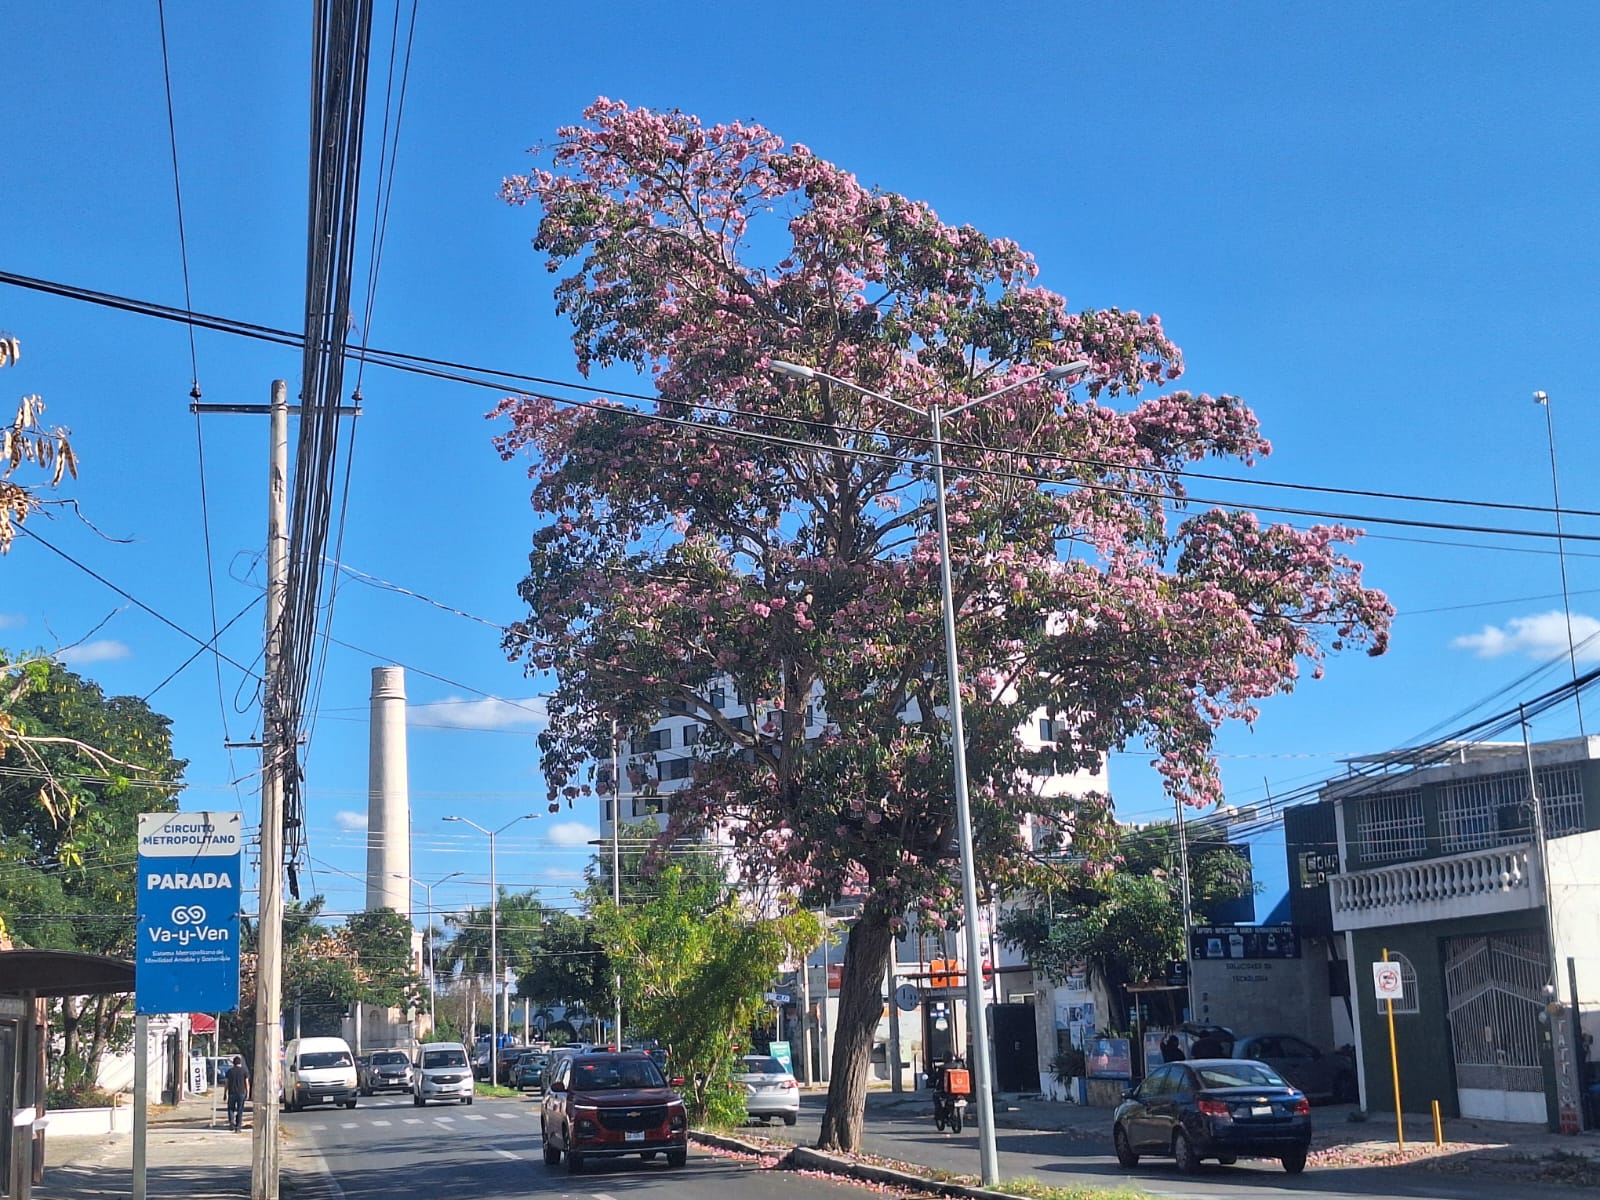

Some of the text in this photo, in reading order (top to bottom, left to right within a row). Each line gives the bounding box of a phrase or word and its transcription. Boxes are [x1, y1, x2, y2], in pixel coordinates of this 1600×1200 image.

[163, 824, 215, 834] CIRCUITO
[143, 835, 235, 845] METROPOLITANO
[147, 872, 232, 890] PARADA
[148, 925, 229, 946] Va-y-Ven
